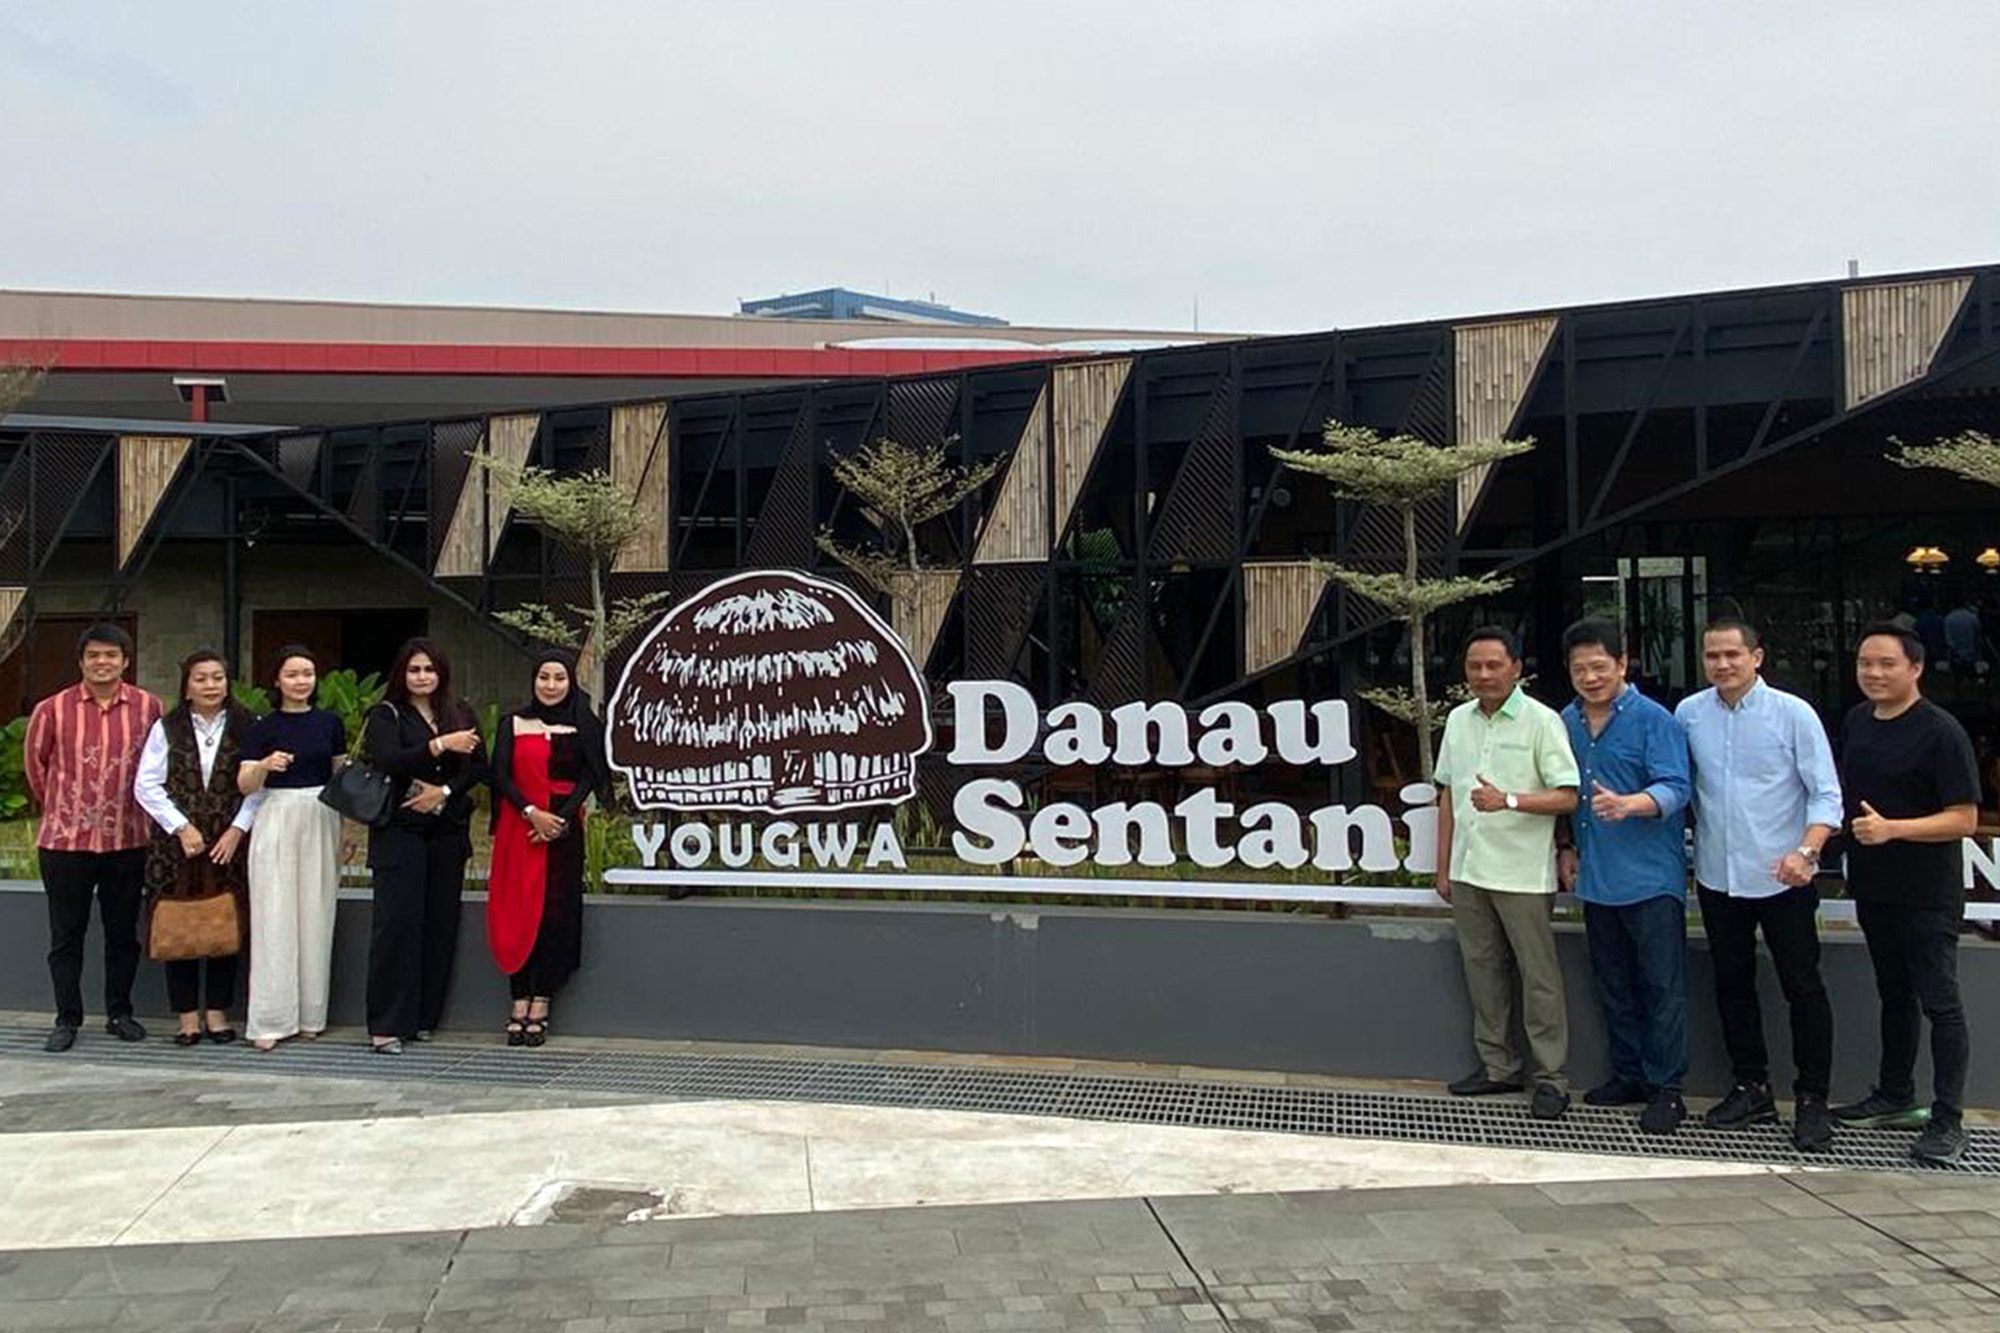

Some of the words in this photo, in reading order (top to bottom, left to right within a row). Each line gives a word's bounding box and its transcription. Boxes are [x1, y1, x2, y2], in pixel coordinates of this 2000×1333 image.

[946, 680, 1357, 766] Danau
[632, 821, 907, 868] YOUGWA
[951, 778, 1439, 873] Sentani
